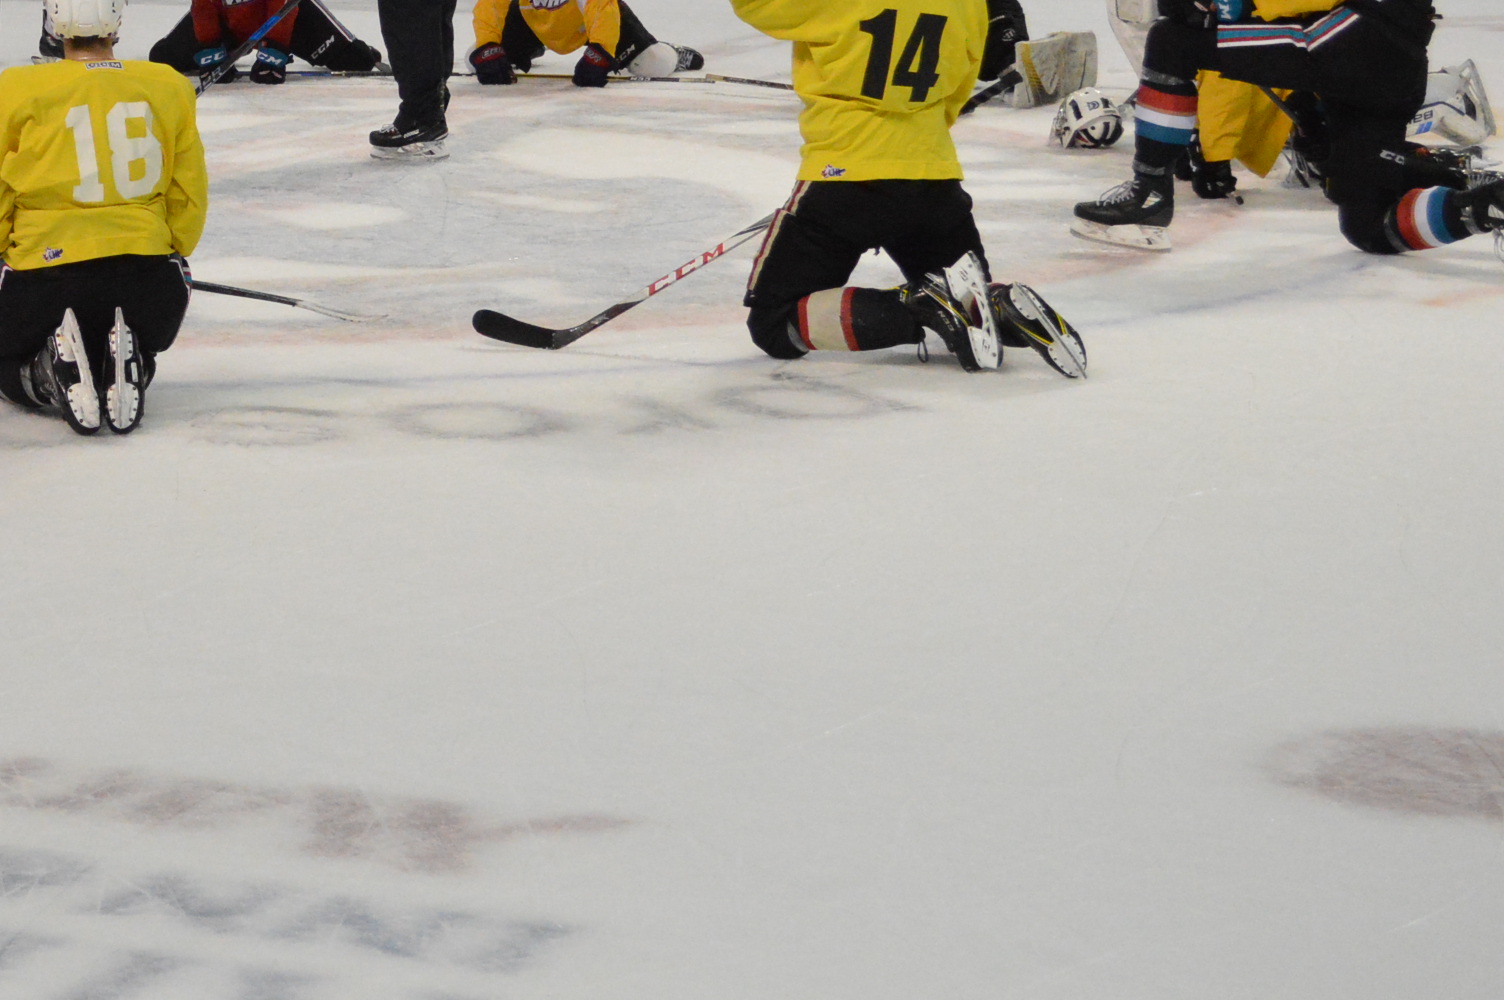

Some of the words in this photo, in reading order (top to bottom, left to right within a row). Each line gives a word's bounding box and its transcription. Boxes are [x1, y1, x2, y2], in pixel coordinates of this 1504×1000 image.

[86, 61, 124, 70] CCM
[311, 35, 336, 60] CCM
[859, 8, 949, 103] 14
[65, 100, 164, 203] 18
[648, 242, 724, 297] CCM
